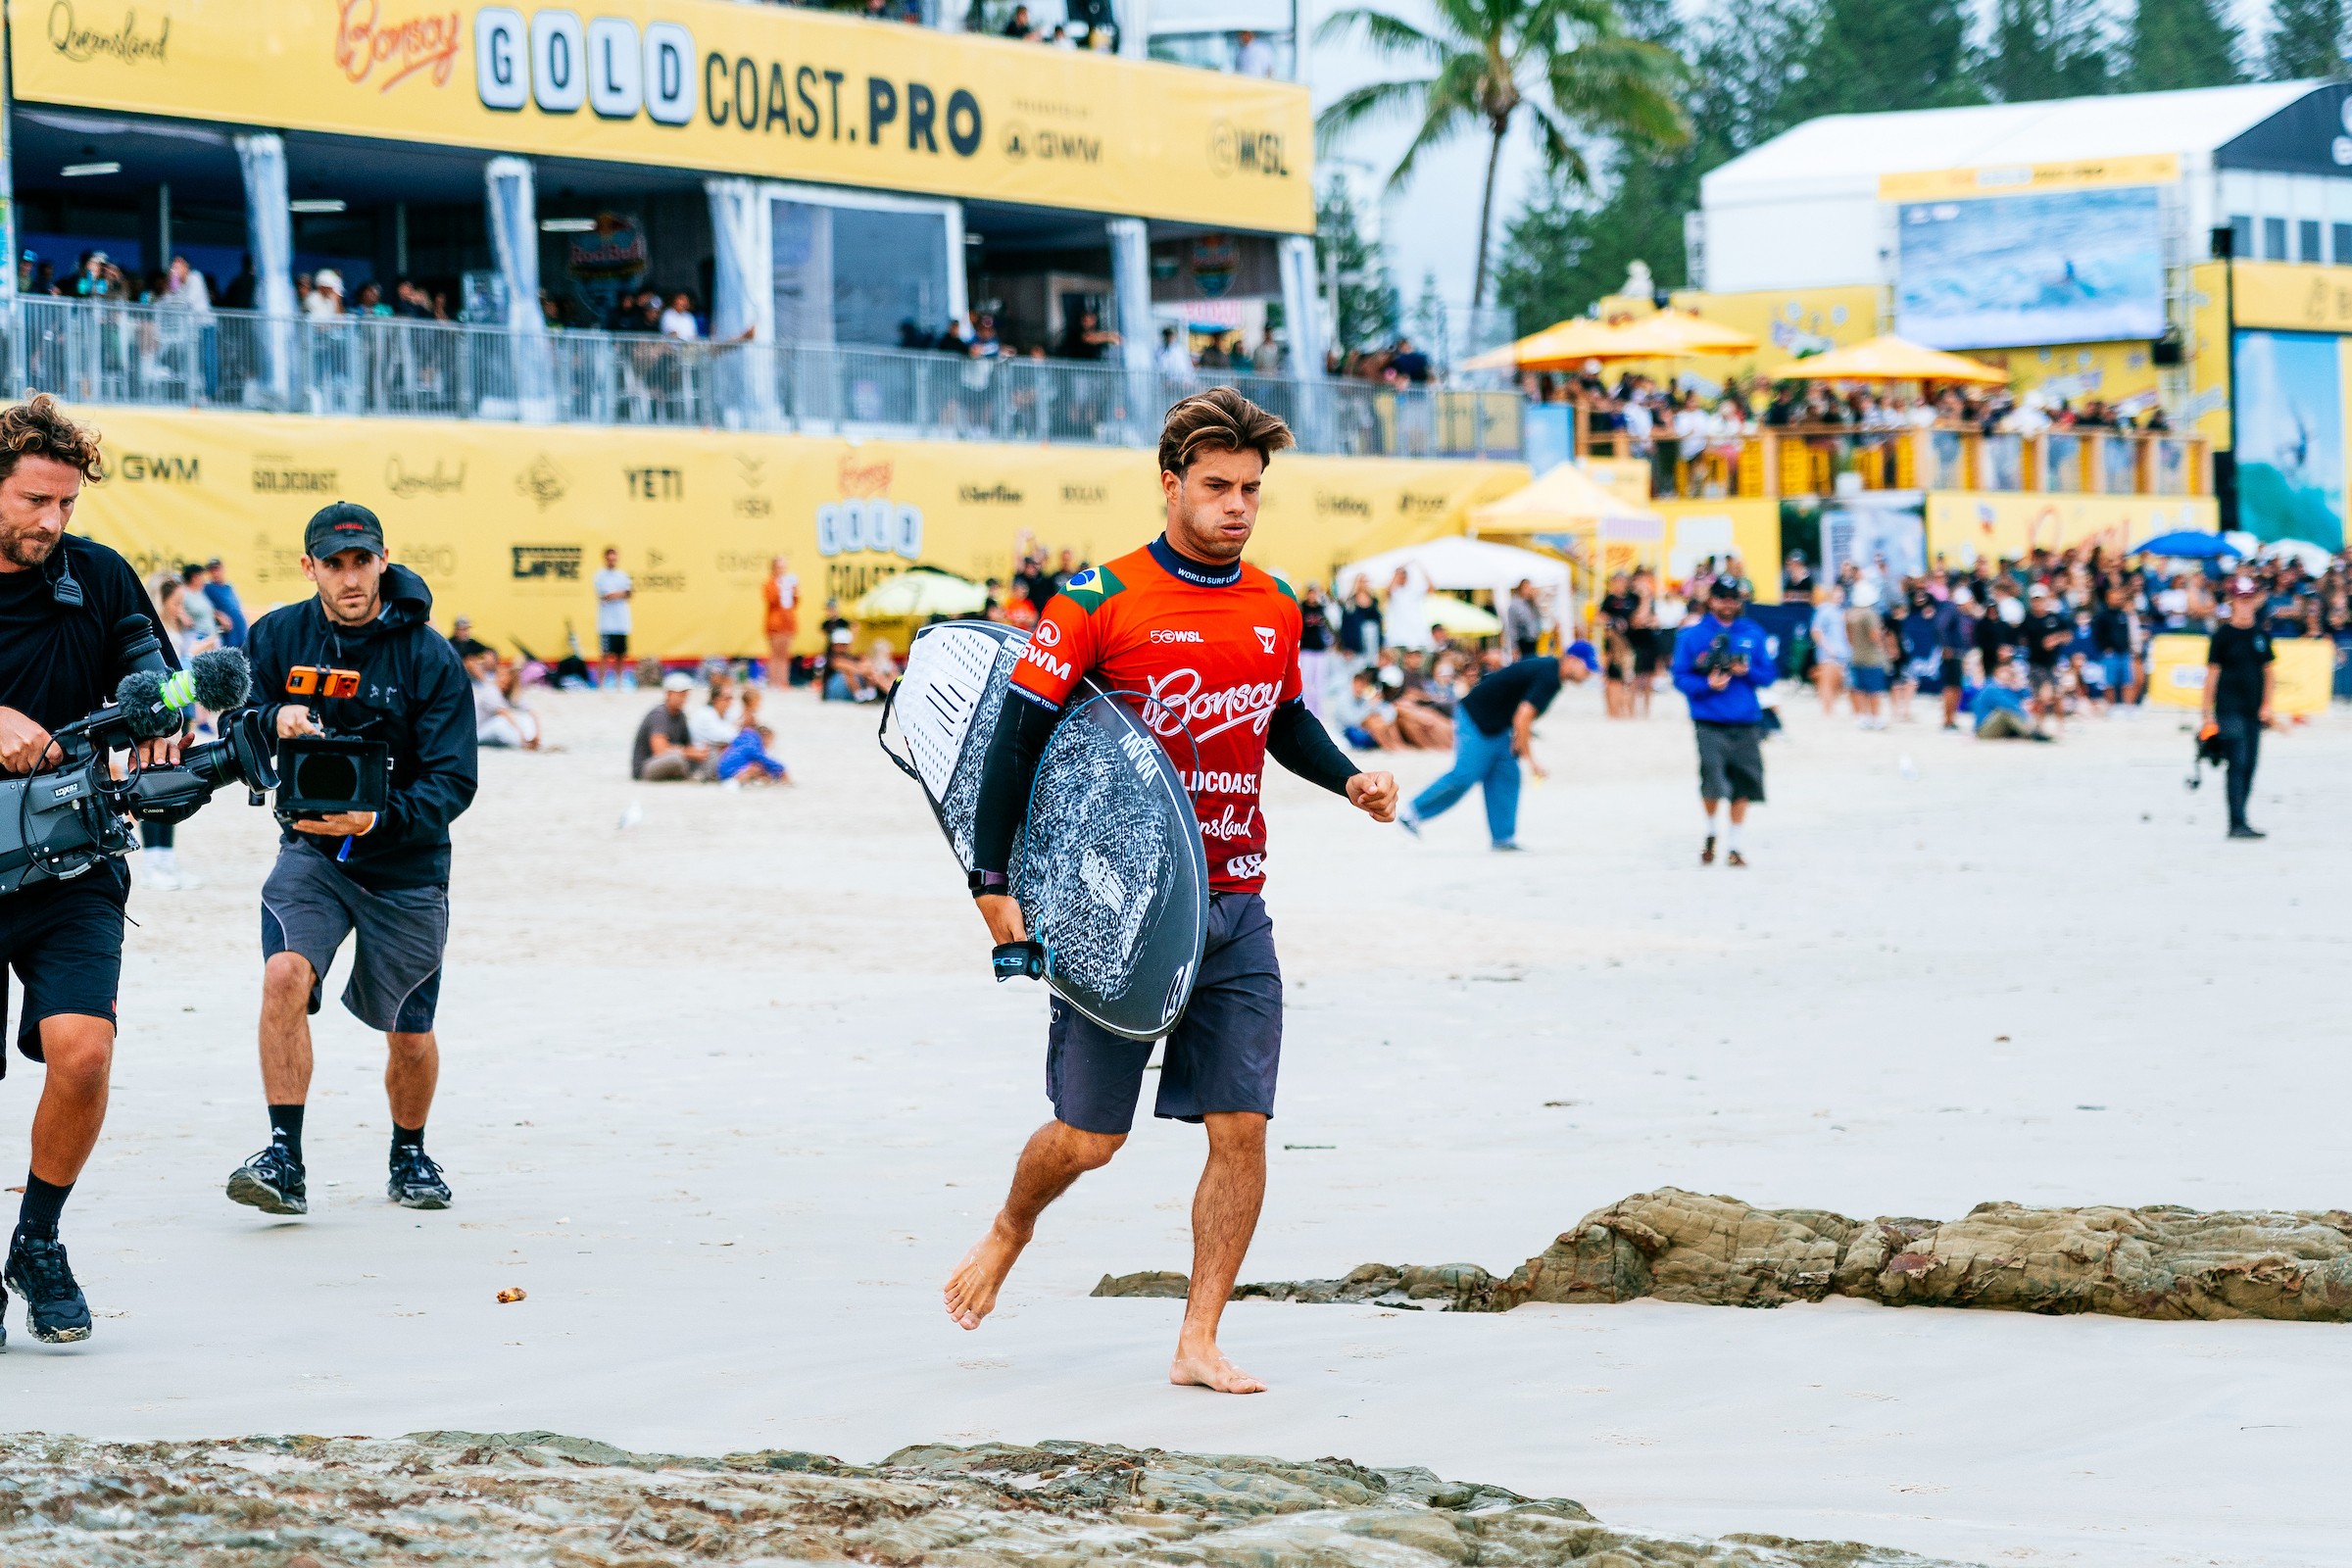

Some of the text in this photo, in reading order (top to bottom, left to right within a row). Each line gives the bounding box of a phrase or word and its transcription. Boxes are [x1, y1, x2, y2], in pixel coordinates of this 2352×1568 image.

[335, 0, 460, 93] Bonsoy
[486, 22, 684, 106] GOLD
[122, 454, 201, 484] GWM
[624, 467, 683, 499] YETI
[1177, 567, 1206, 583] WORLD
[1206, 576, 1226, 585] SURF
[1020, 641, 1072, 681] GWM
[1041, 698, 1060, 712] TOUR
[1142, 667, 1283, 743] Bonsoy
[1179, 770, 1259, 795] LDCOAST.
[1198, 804, 1255, 841] nsland
[994, 956, 1023, 967] FCS
